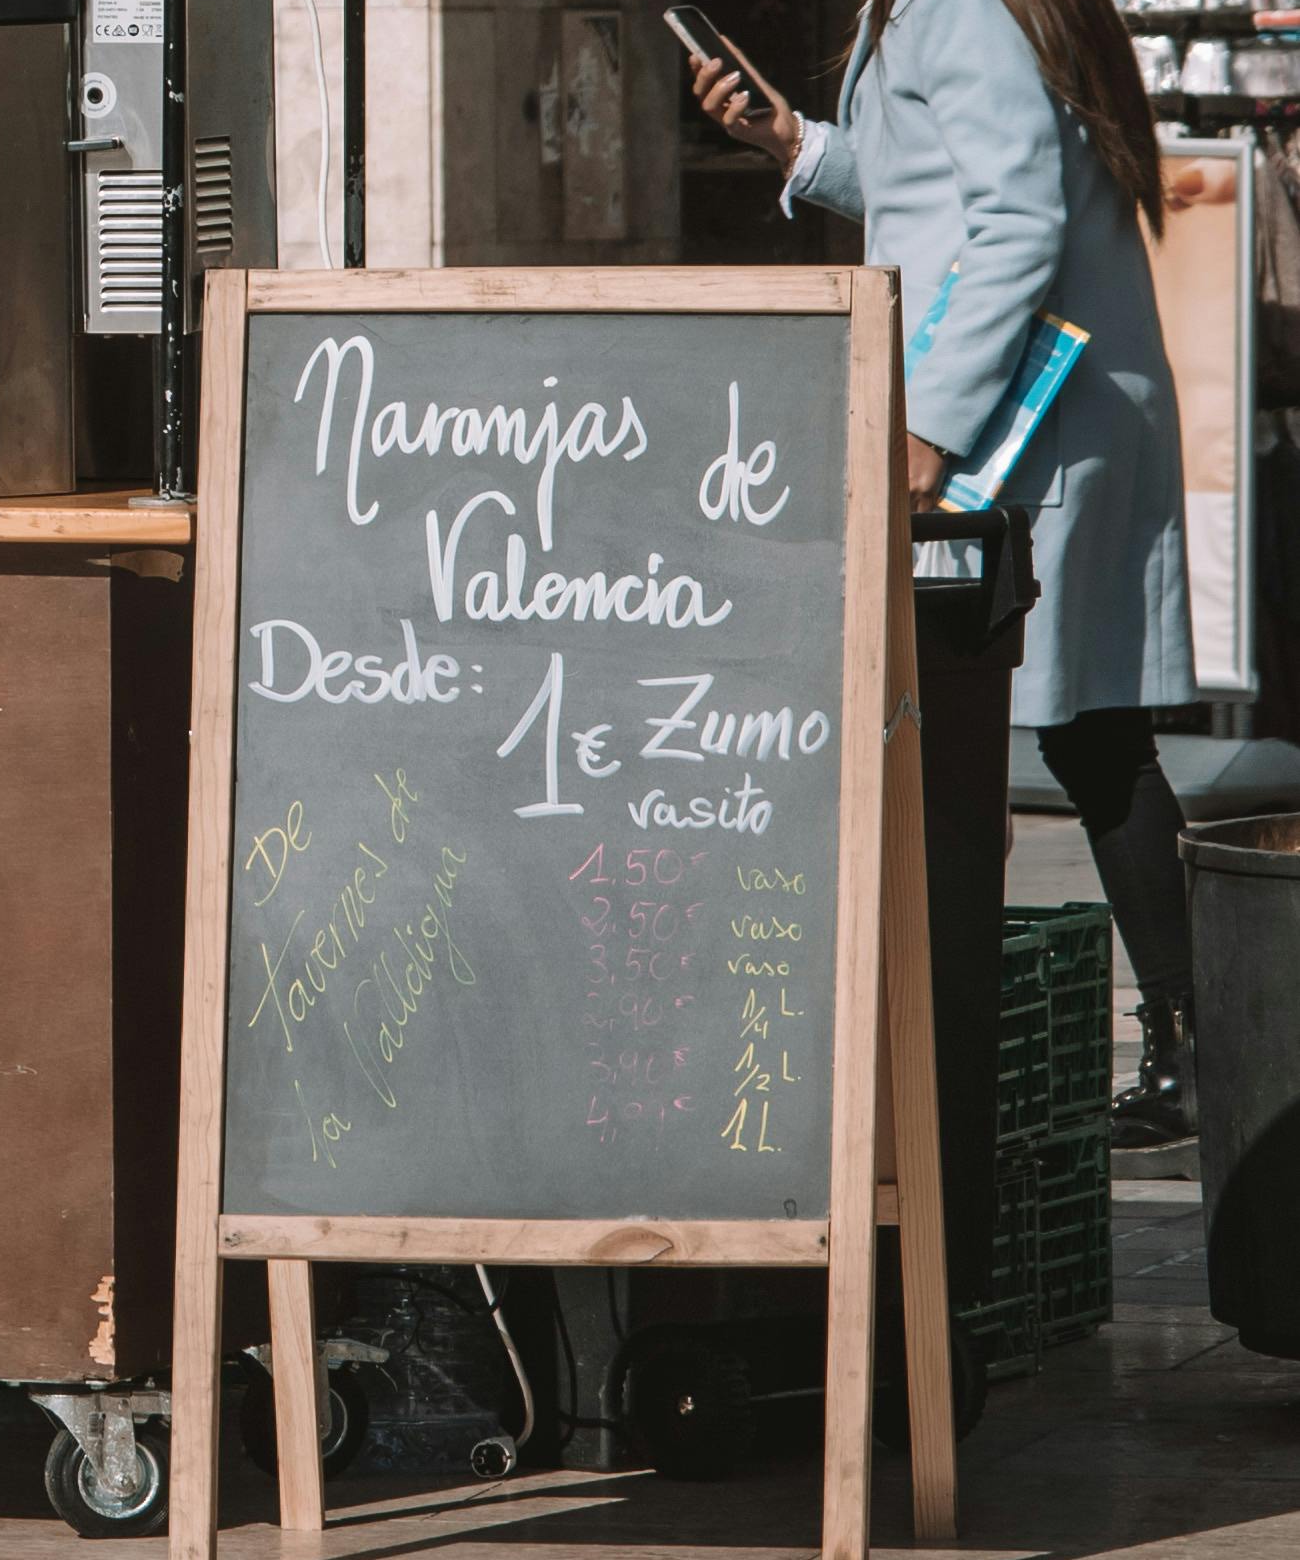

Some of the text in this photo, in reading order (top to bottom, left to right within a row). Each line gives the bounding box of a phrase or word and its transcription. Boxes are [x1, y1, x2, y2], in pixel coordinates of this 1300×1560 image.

[293, 334, 790, 552] Naranjas de
[425, 490, 733, 629] Valencia
[248, 618, 484, 705] Desde:
[636, 673, 831, 762] Zumo
[627, 772, 773, 835] vasito
[245, 800, 313, 907] De
[736, 864, 807, 896] vaso
[726, 952, 791, 977] vaso
[731, 914, 802, 941] vaso
